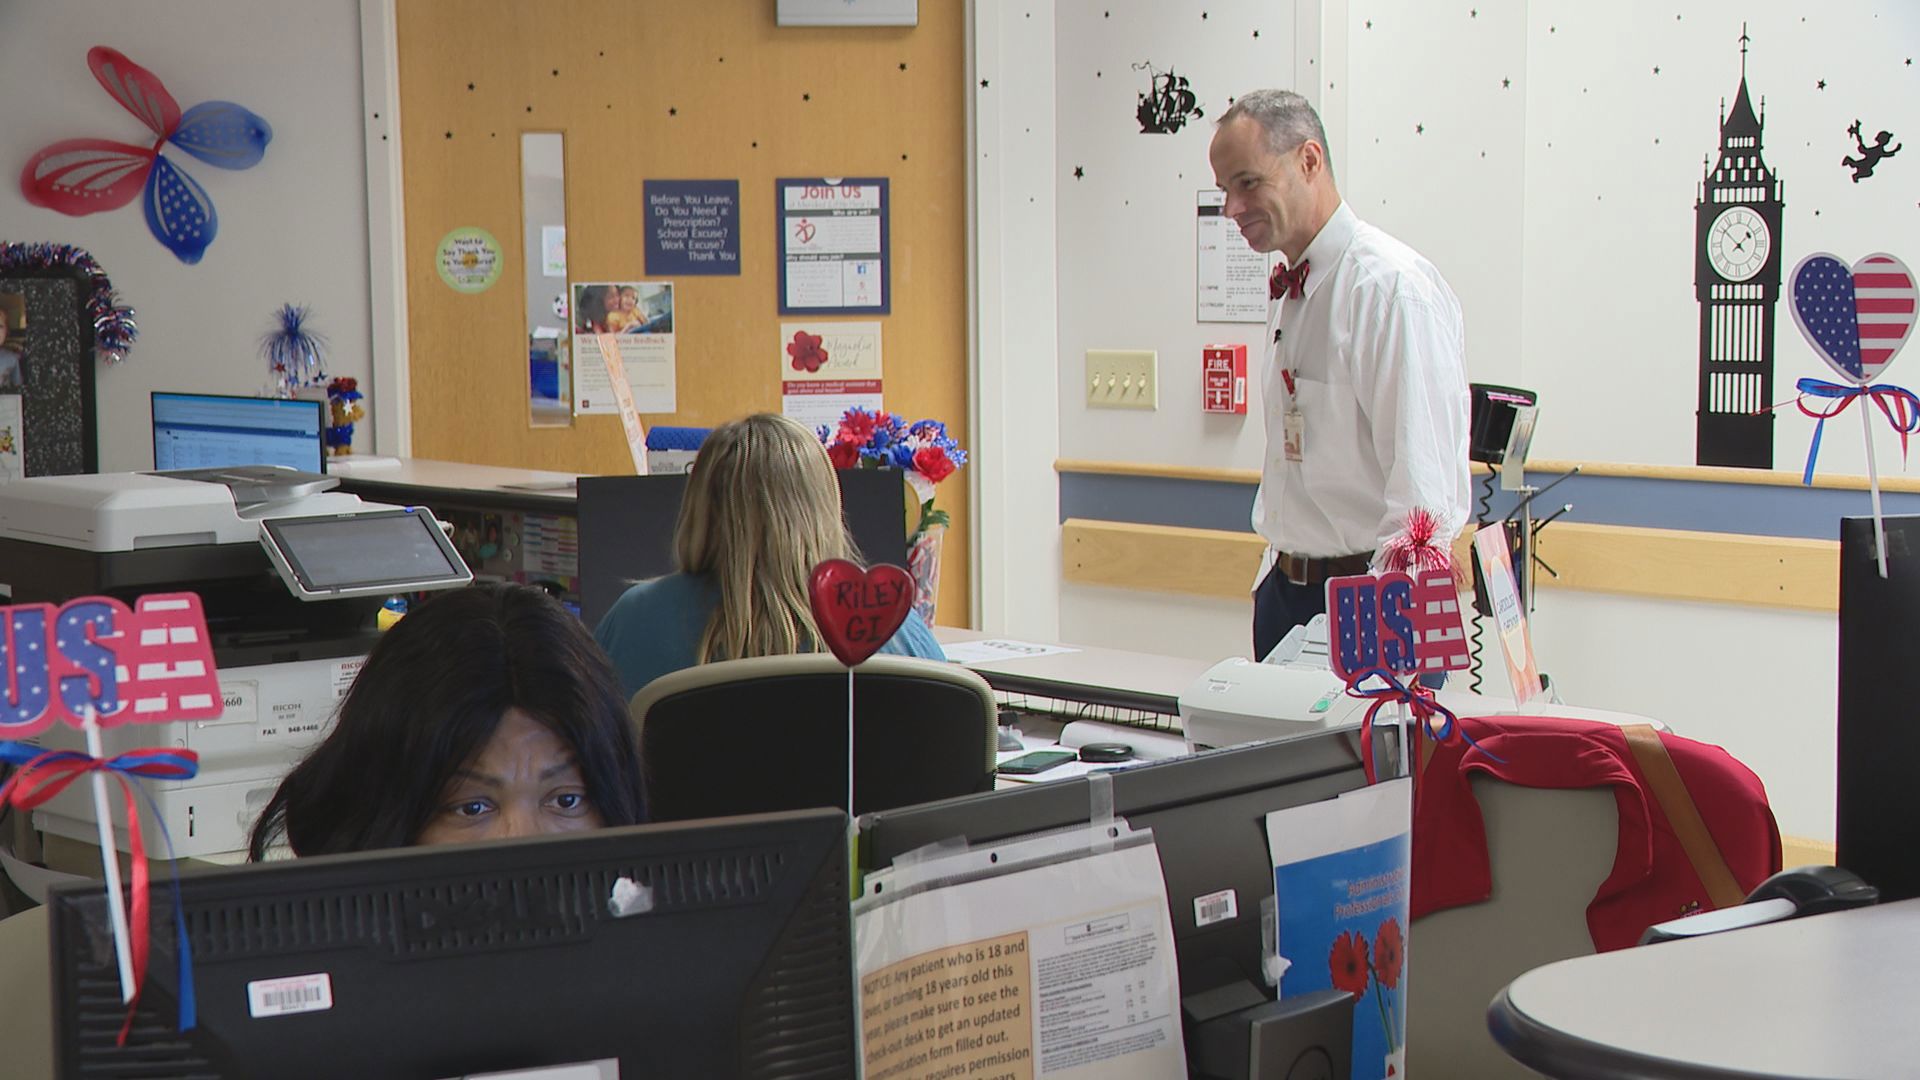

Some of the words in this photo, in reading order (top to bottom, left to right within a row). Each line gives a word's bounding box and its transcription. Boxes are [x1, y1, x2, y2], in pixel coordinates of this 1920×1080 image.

[800, 186, 835, 200] Join
[841, 186, 862, 199] Us
[650, 194, 681, 205] Before
[684, 195, 701, 205] You
[704, 194, 733, 206] Leave,
[655, 206, 669, 216] Do
[672, 206, 690, 216] You
[692, 205, 717, 216] Need
[663, 217, 722, 229] Prescription?
[657, 228, 689, 239] School
[691, 228, 729, 239] Excuse?
[660, 239, 686, 250] Work
[688, 239, 726, 250] Excuse?
[458, 247, 479, 256] Thank
[688, 251, 716, 261] Thank
[719, 251, 737, 261] You
[1208, 359, 1230, 369] FIRE
[846, 615, 883, 643] GI
[1336, 577, 1469, 676] USA
[222, 697, 243, 708] 660
[272, 703, 301, 711] RICOH
[262, 728, 277, 736] FAX
[894, 969, 910, 984] Any
[911, 957, 945, 981] patient
[947, 951, 973, 967] who
[975, 948, 985, 961] is
[988, 944, 1002, 959] 18
[1004, 938, 1026, 956] and
[892, 987, 924, 1008] turning
[926, 980, 938, 996] 18
[939, 973, 969, 994] years
[971, 969, 990, 985] old
[992, 963, 1014, 979] this
[884, 1014, 909, 1035] please
[910, 1005, 935, 1021] make
[937, 998, 960, 1014] sure
[962, 994, 975, 1008] to
[978, 990, 997, 1005] see
[1000, 984, 1020, 1000] the
[866, 1037, 903, 1065] check-out
[904, 1028, 925, 1048] desk
[925, 1026, 936, 1040] to
[937, 1021, 954, 1039] get
[956, 1018, 971, 1031] an
[973, 1003, 1021, 1029] updated
[929, 1044, 953, 1061] form
[956, 1033, 983, 1053] filled
[986, 1030, 1009, 1046] out.
[926, 1062, 966, 1080] requires
[969, 1047, 1030, 1075] permission
